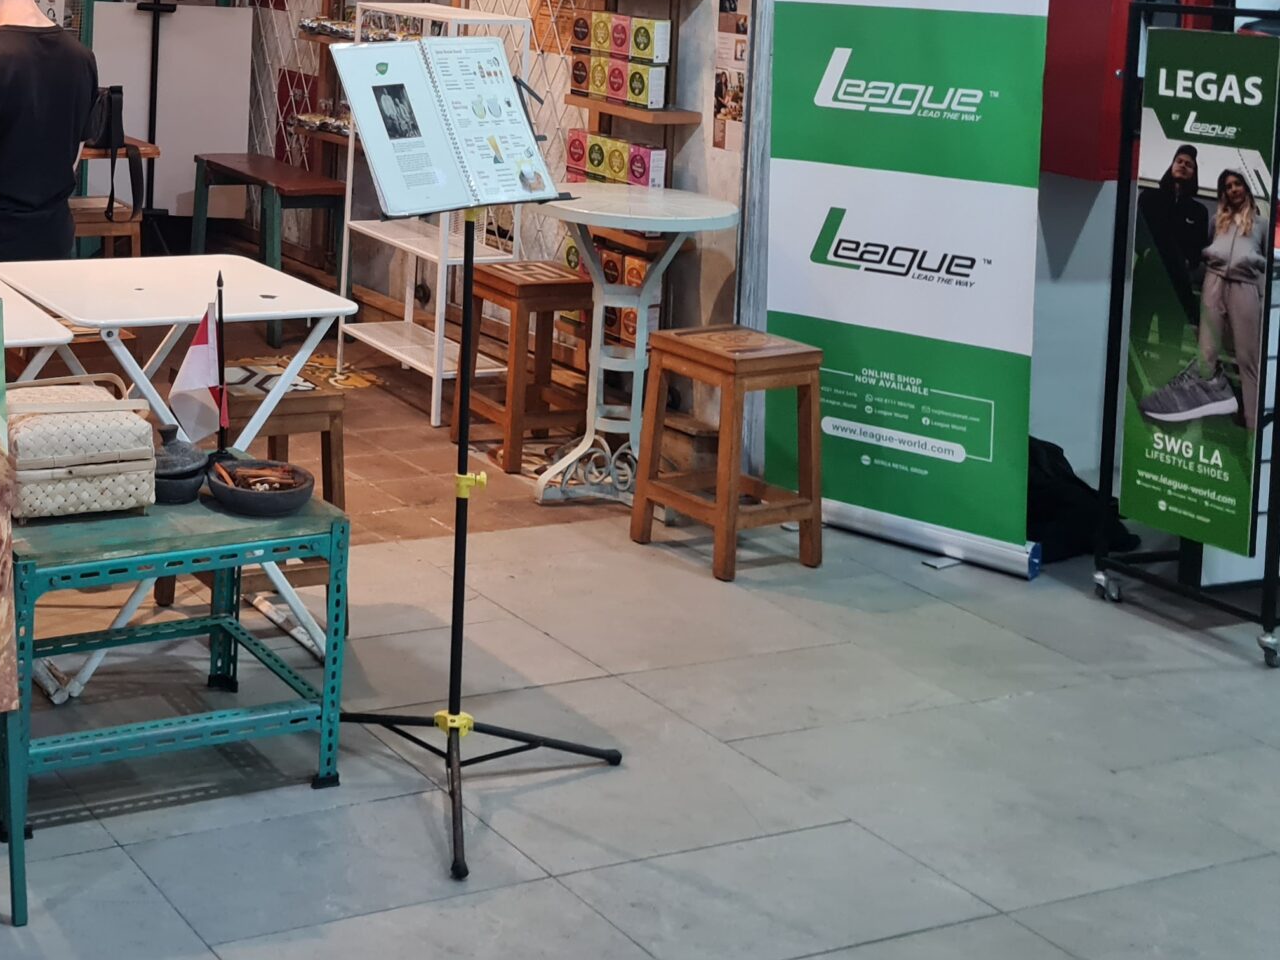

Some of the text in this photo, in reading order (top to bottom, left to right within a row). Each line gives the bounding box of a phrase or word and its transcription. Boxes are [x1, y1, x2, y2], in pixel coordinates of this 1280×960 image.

[813, 47, 984, 115] League
[1158, 67, 1263, 107] LEGAS
[917, 108, 983, 123] LEAD THE WAY
[1183, 110, 1238, 137] League
[809, 206, 977, 278] League
[911, 272, 976, 289] LEAD THE WAY
[854, 375, 929, 396] NOW AVAILABLE
[861, 367, 923, 386] ONLINE SHOP
[831, 422, 955, 457] www.league-world.com
[1152, 431, 1223, 469] SWG LA
[1145, 448, 1230, 482] LIFESTYLE SHOES
[1136, 468, 1237, 507] www.league-world.com
